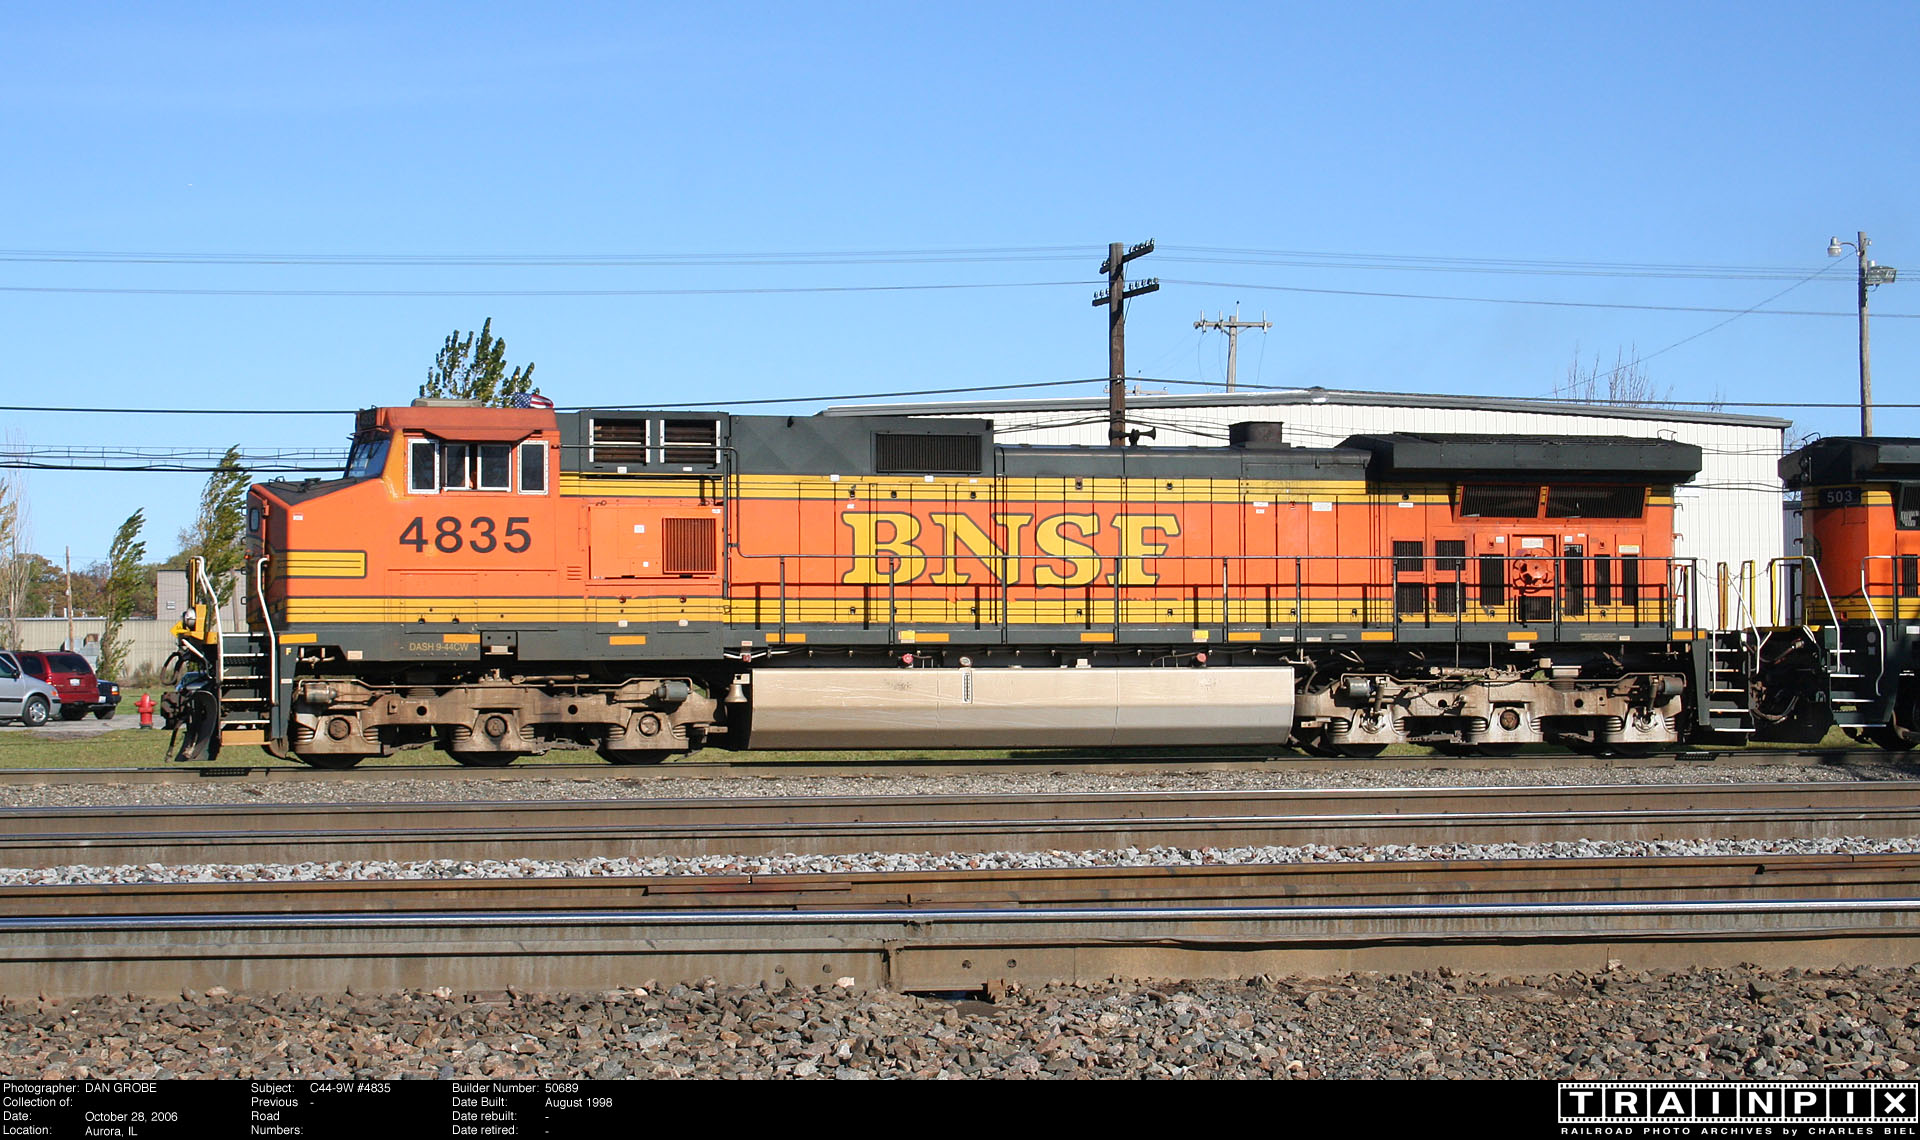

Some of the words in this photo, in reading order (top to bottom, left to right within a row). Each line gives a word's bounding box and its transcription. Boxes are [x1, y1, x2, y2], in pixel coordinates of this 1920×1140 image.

[1826, 490, 1853, 503] 503
[399, 516, 531, 553] 4835
[841, 511, 1181, 589] BNSF
[409, 642, 434, 652] DASH
[436, 642, 469, 652] 9-44CW
